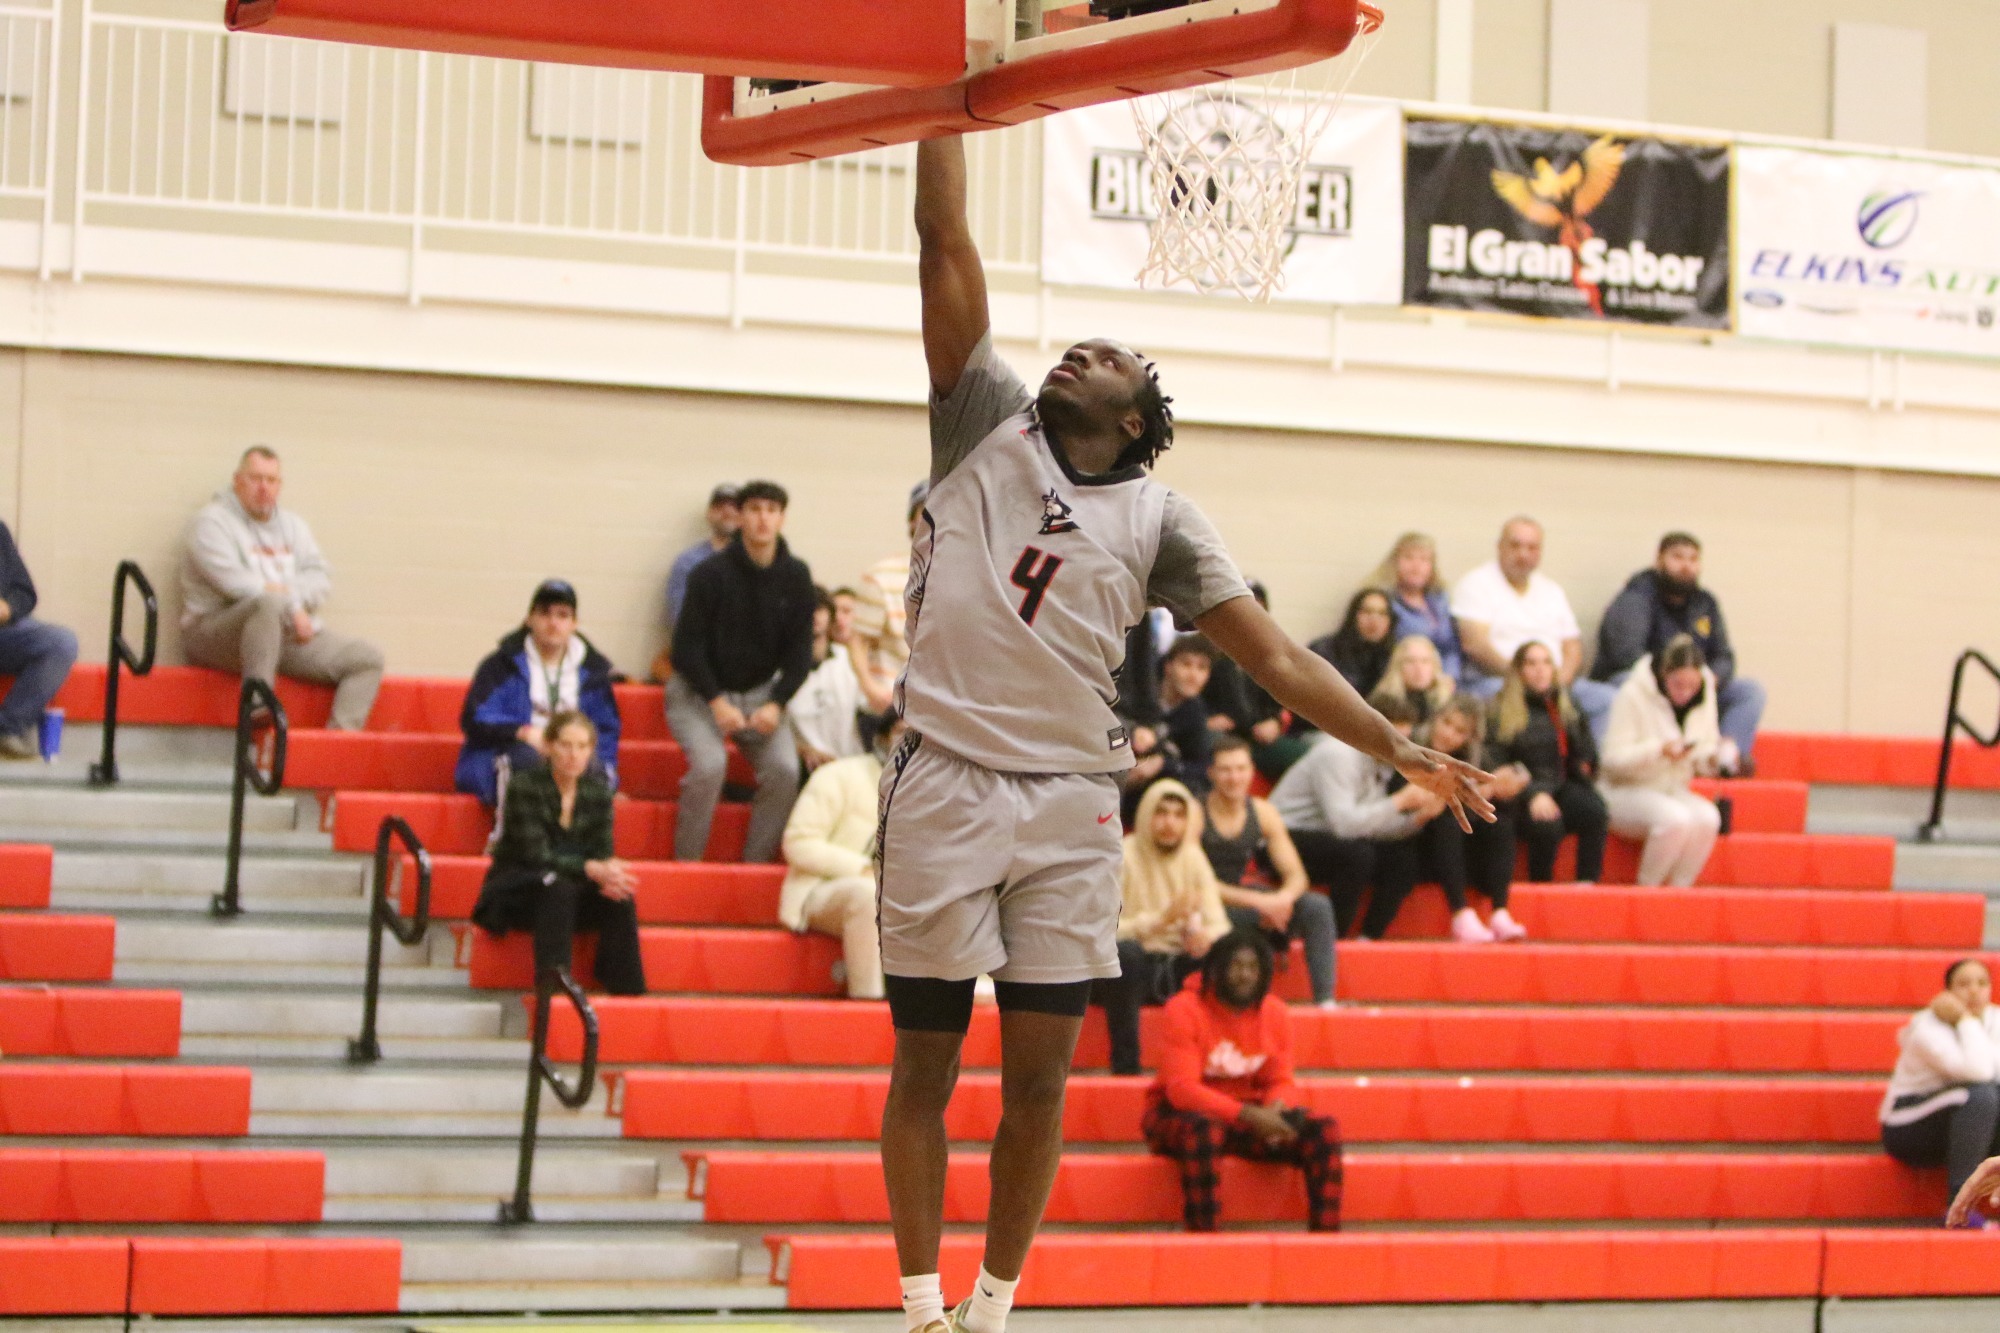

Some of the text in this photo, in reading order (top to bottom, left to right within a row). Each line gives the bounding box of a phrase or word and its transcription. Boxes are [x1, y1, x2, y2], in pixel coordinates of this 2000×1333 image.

[1428, 224, 1704, 290] El Gran Sabor
[1750, 249, 1904, 287] ELKINS
[1009, 545, 1063, 627] 4
